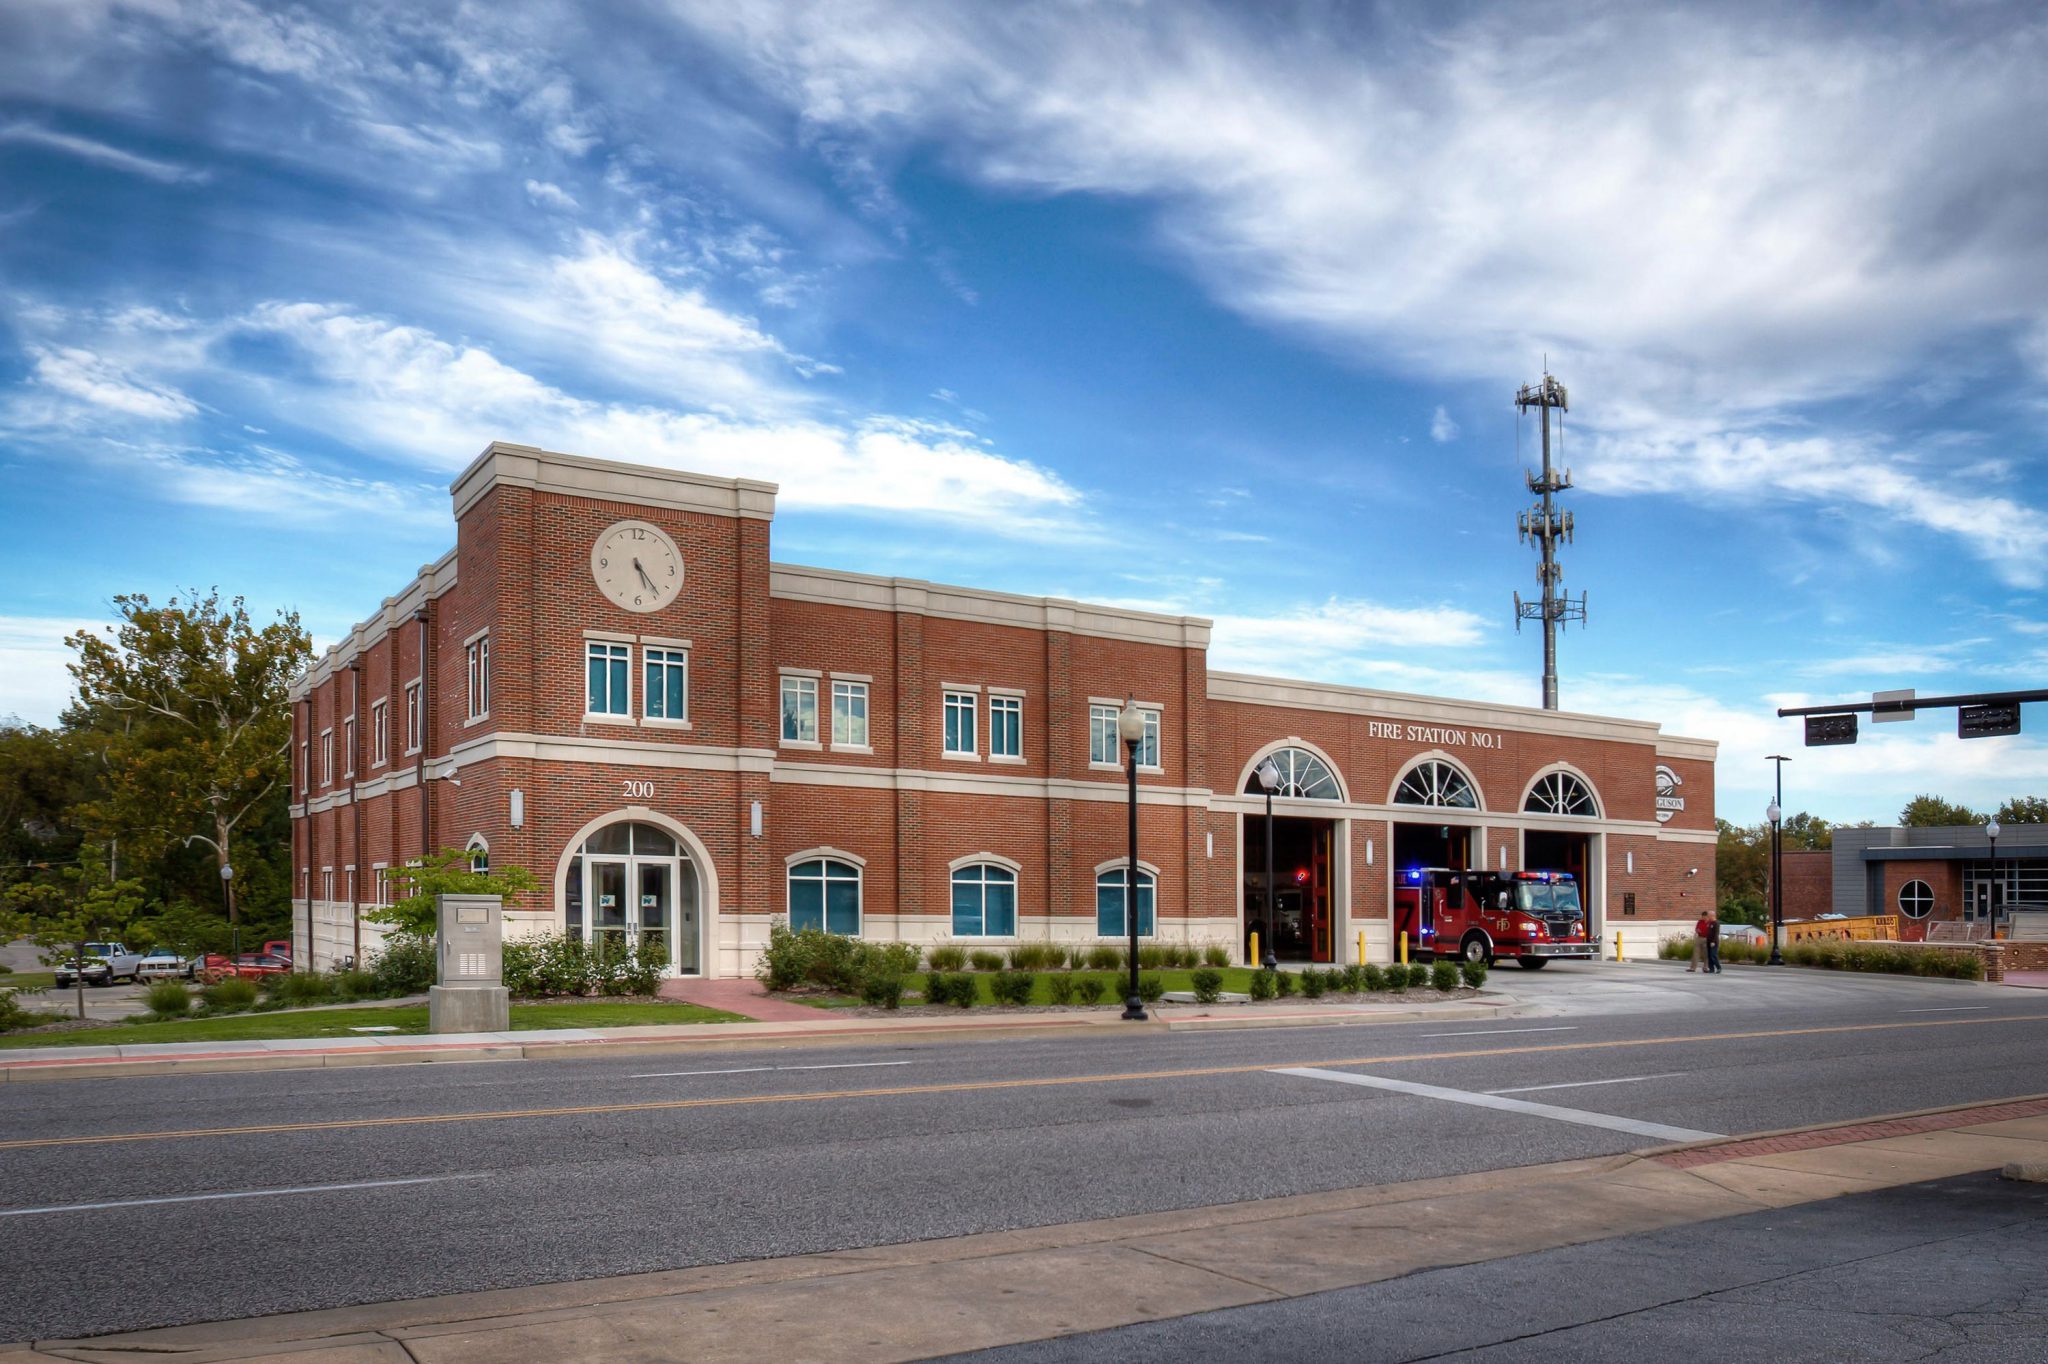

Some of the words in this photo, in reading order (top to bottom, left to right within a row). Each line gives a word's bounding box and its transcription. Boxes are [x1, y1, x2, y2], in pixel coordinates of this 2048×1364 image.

[631, 528, 646, 541] 12
[600, 558, 608, 569] 9
[667, 565, 675, 577] 3
[634, 595, 642, 606] 6
[1368, 721, 1402, 740] FIRE
[1407, 725, 1466, 746] STATION
[622, 780, 654, 798] 200
[1656, 798, 1682, 809] GUSON
